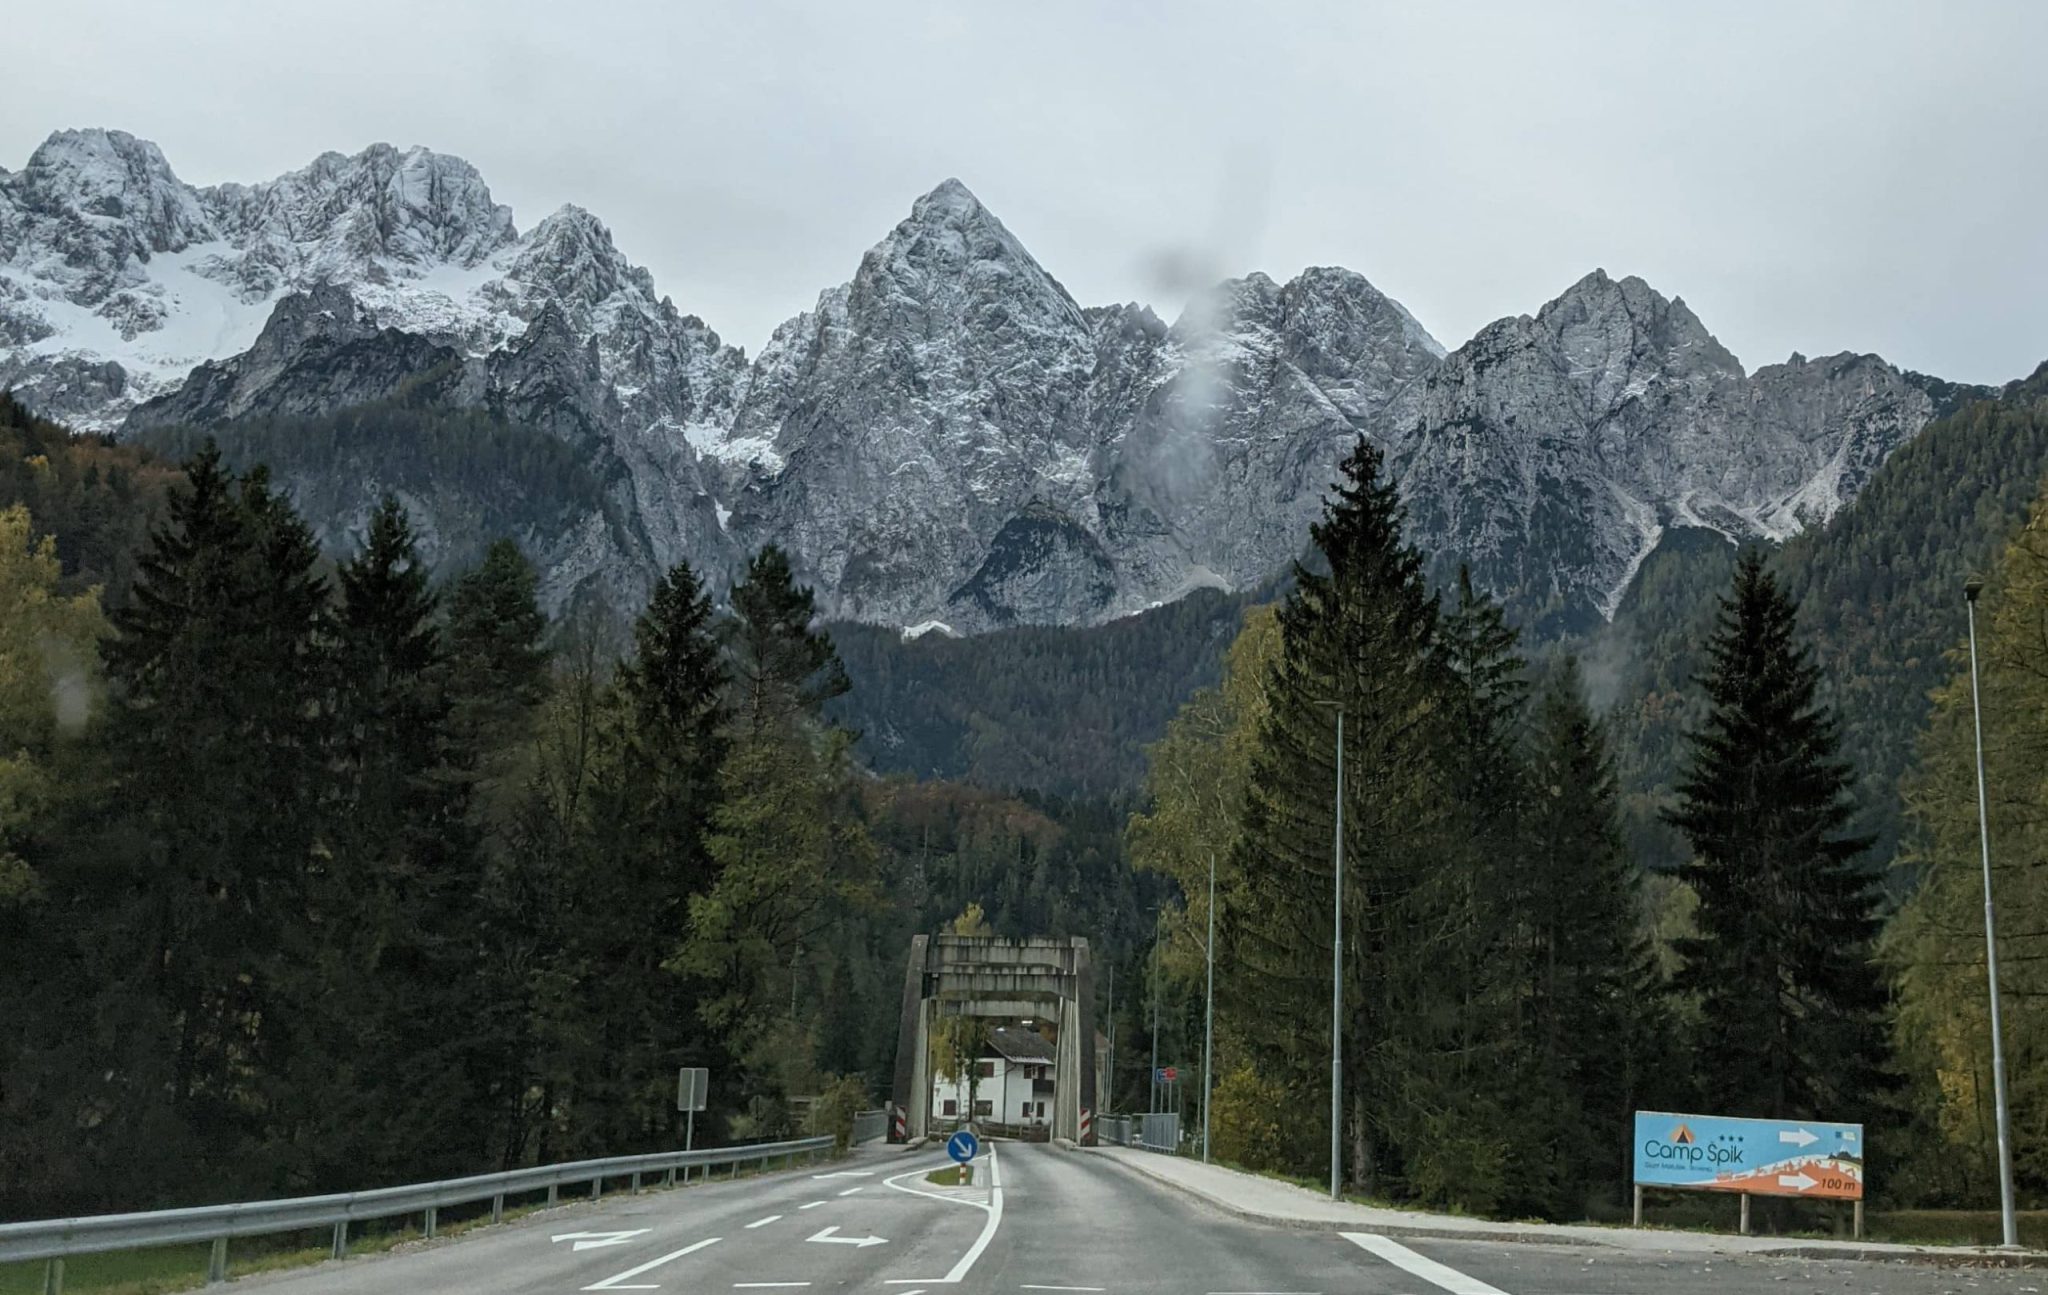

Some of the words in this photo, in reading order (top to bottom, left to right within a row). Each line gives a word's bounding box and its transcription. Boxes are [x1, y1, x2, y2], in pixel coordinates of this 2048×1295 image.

[1645, 1140, 1703, 1164] Camp
[1822, 1178, 1842, 1190] 100
[1844, 1182, 1855, 1191] m
